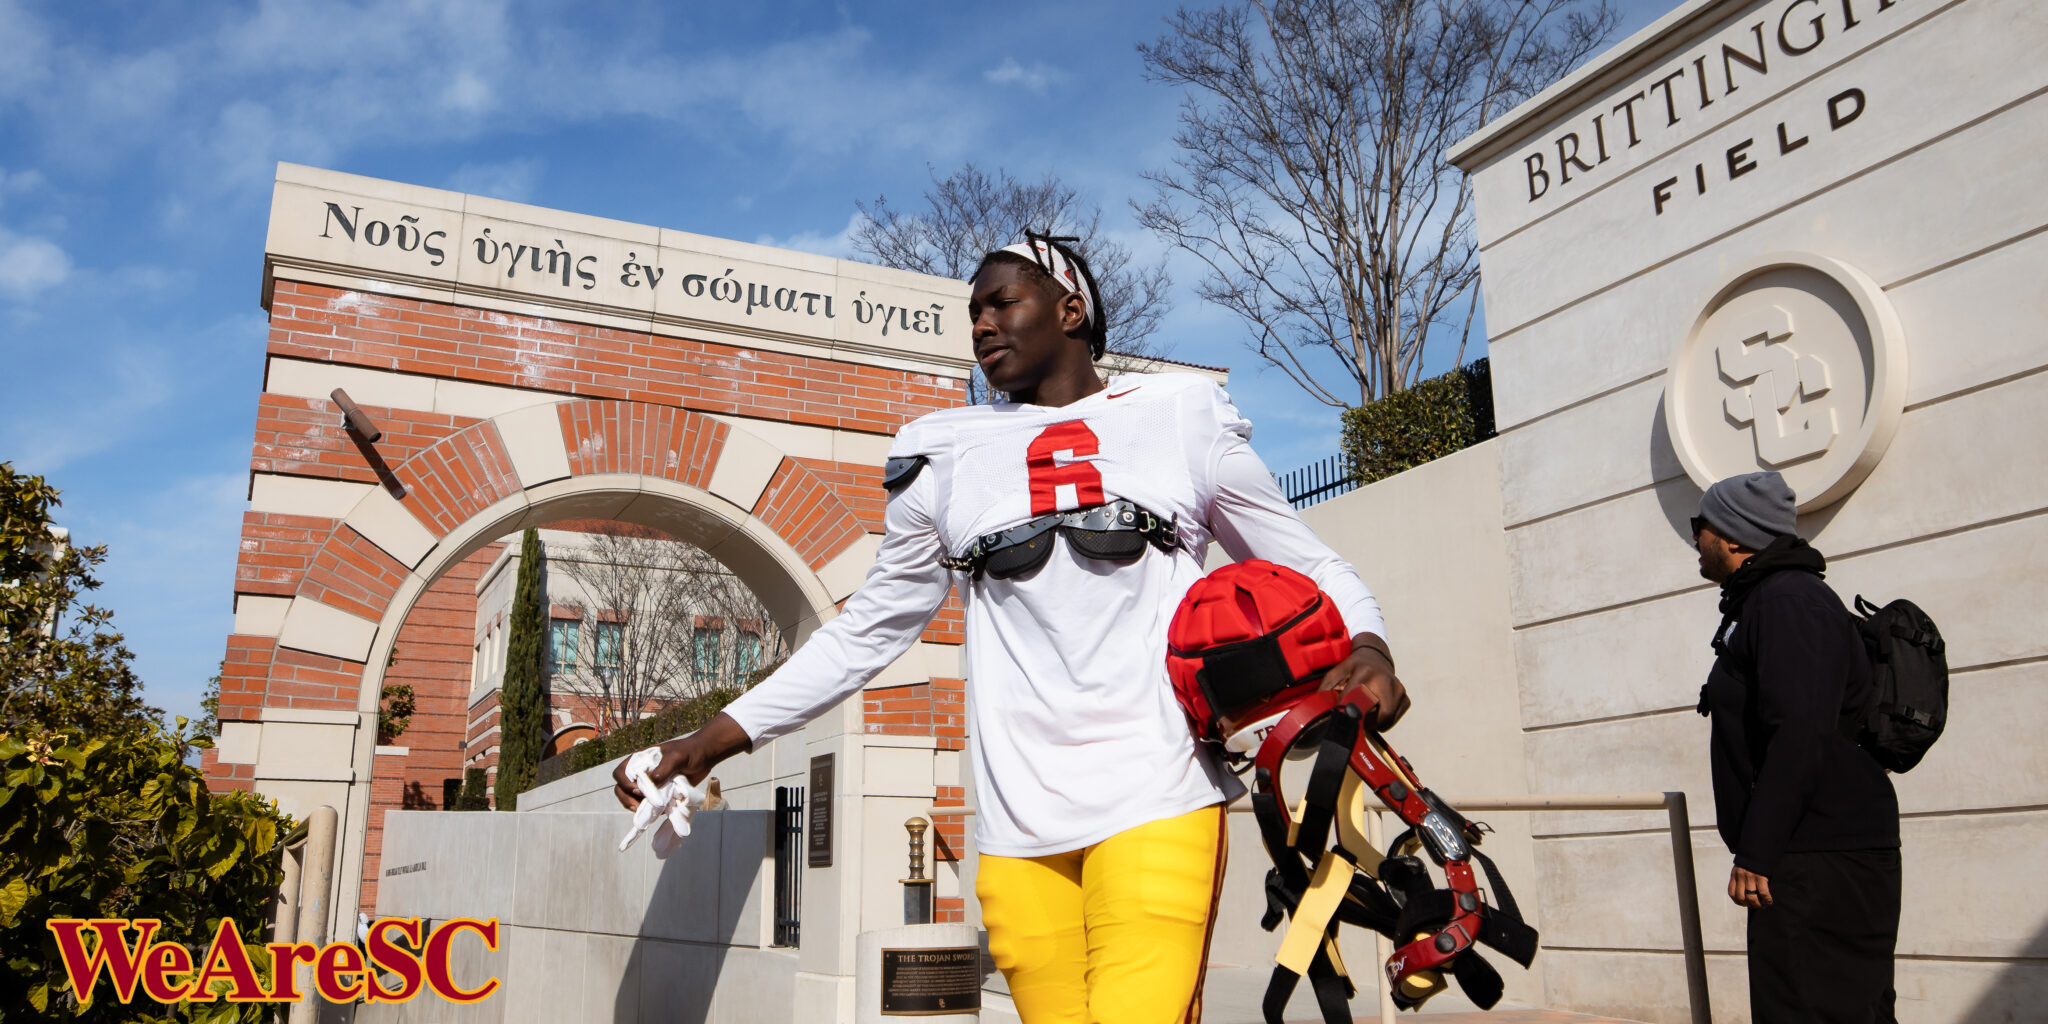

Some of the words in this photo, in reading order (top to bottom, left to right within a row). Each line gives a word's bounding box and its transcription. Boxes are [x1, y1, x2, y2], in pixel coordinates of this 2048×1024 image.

[1653, 87, 1866, 215] FIELD
[897, 954, 916, 963] THE
[918, 953, 951, 964] TROJAN
